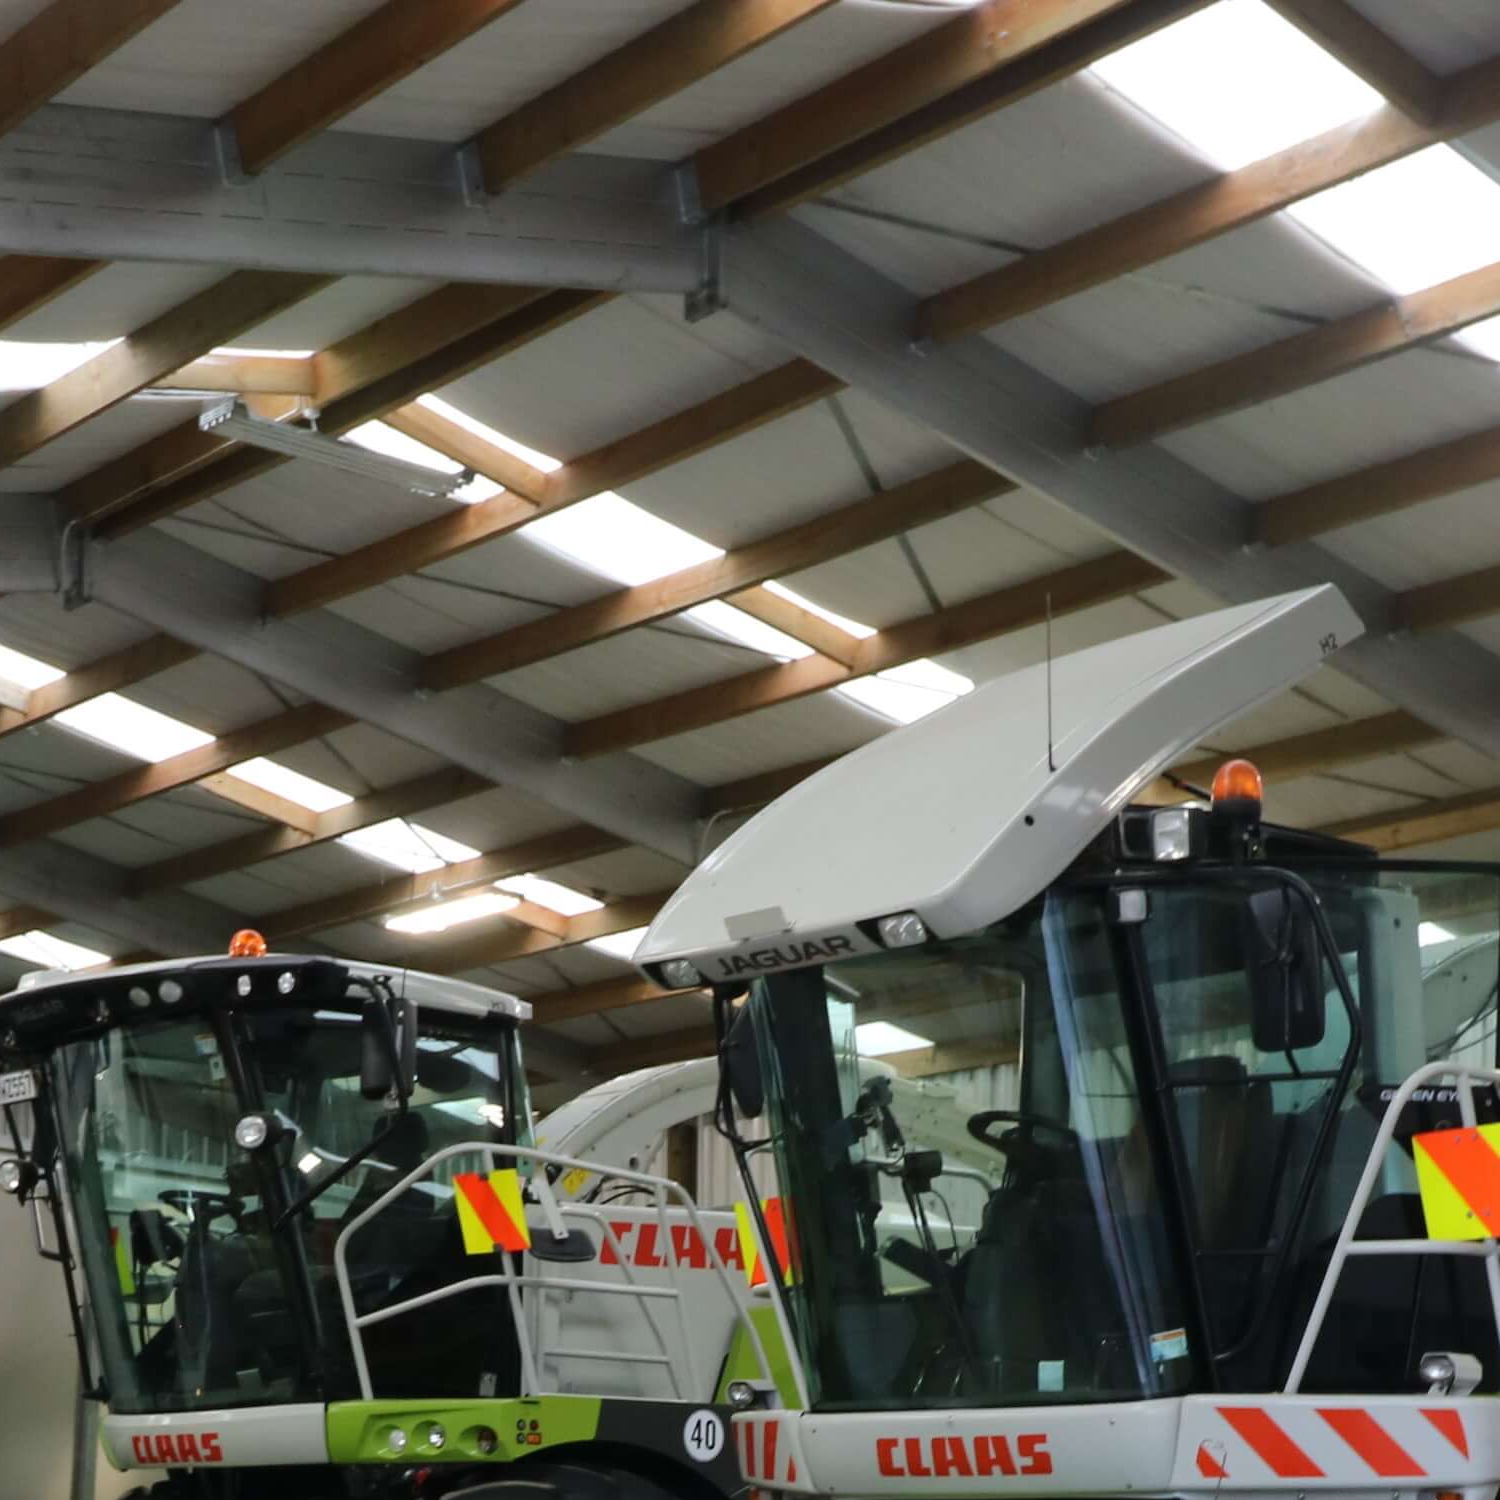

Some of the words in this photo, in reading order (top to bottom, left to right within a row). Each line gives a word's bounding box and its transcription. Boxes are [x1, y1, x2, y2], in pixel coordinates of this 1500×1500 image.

[717, 936, 856, 977] JAGUAR
[1437, 1089, 1461, 1102] EY
[600, 1222, 747, 1271] CLAA
[132, 1433, 224, 1464] CLAAS
[691, 1419, 716, 1450] 40
[876, 1433, 1053, 1477] CLAAS
